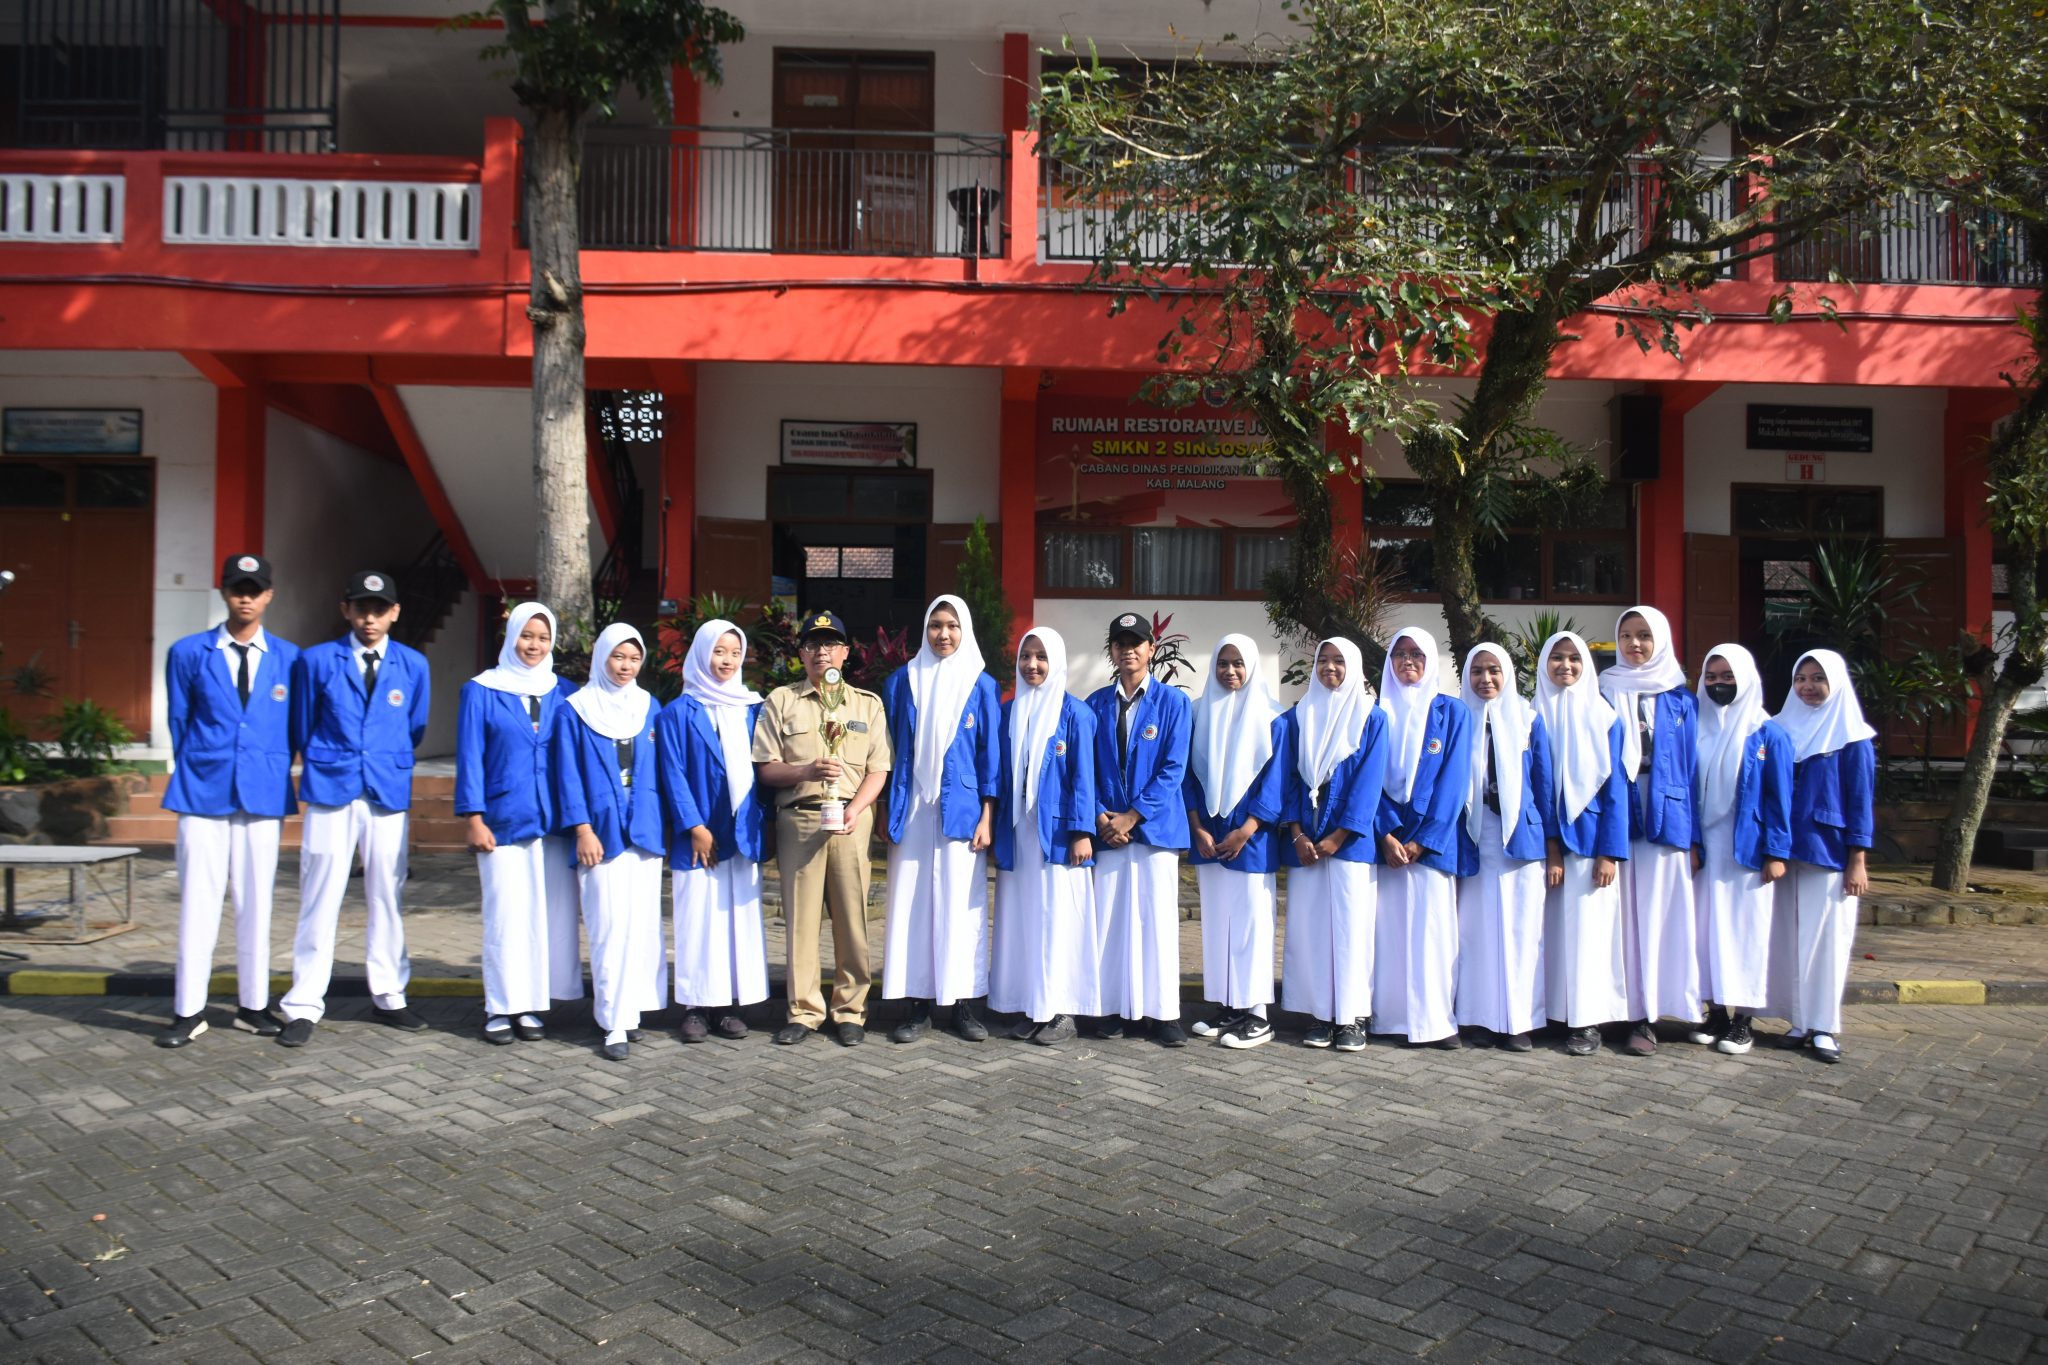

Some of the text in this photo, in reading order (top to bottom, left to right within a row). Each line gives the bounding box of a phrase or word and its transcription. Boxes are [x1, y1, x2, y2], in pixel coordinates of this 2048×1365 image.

[1052, 418, 1119, 433] RUMAH
[1124, 418, 1245, 434] RESTORATIVE
[1092, 440, 1274, 457] SMKN 2 SINGOSAR
[1080, 464, 1129, 474] CABANG
[1132, 464, 1167, 474] DINAS
[1170, 464, 1239, 475] PENDIDIKAN
[1146, 479, 1226, 489] KAB. MALANG
